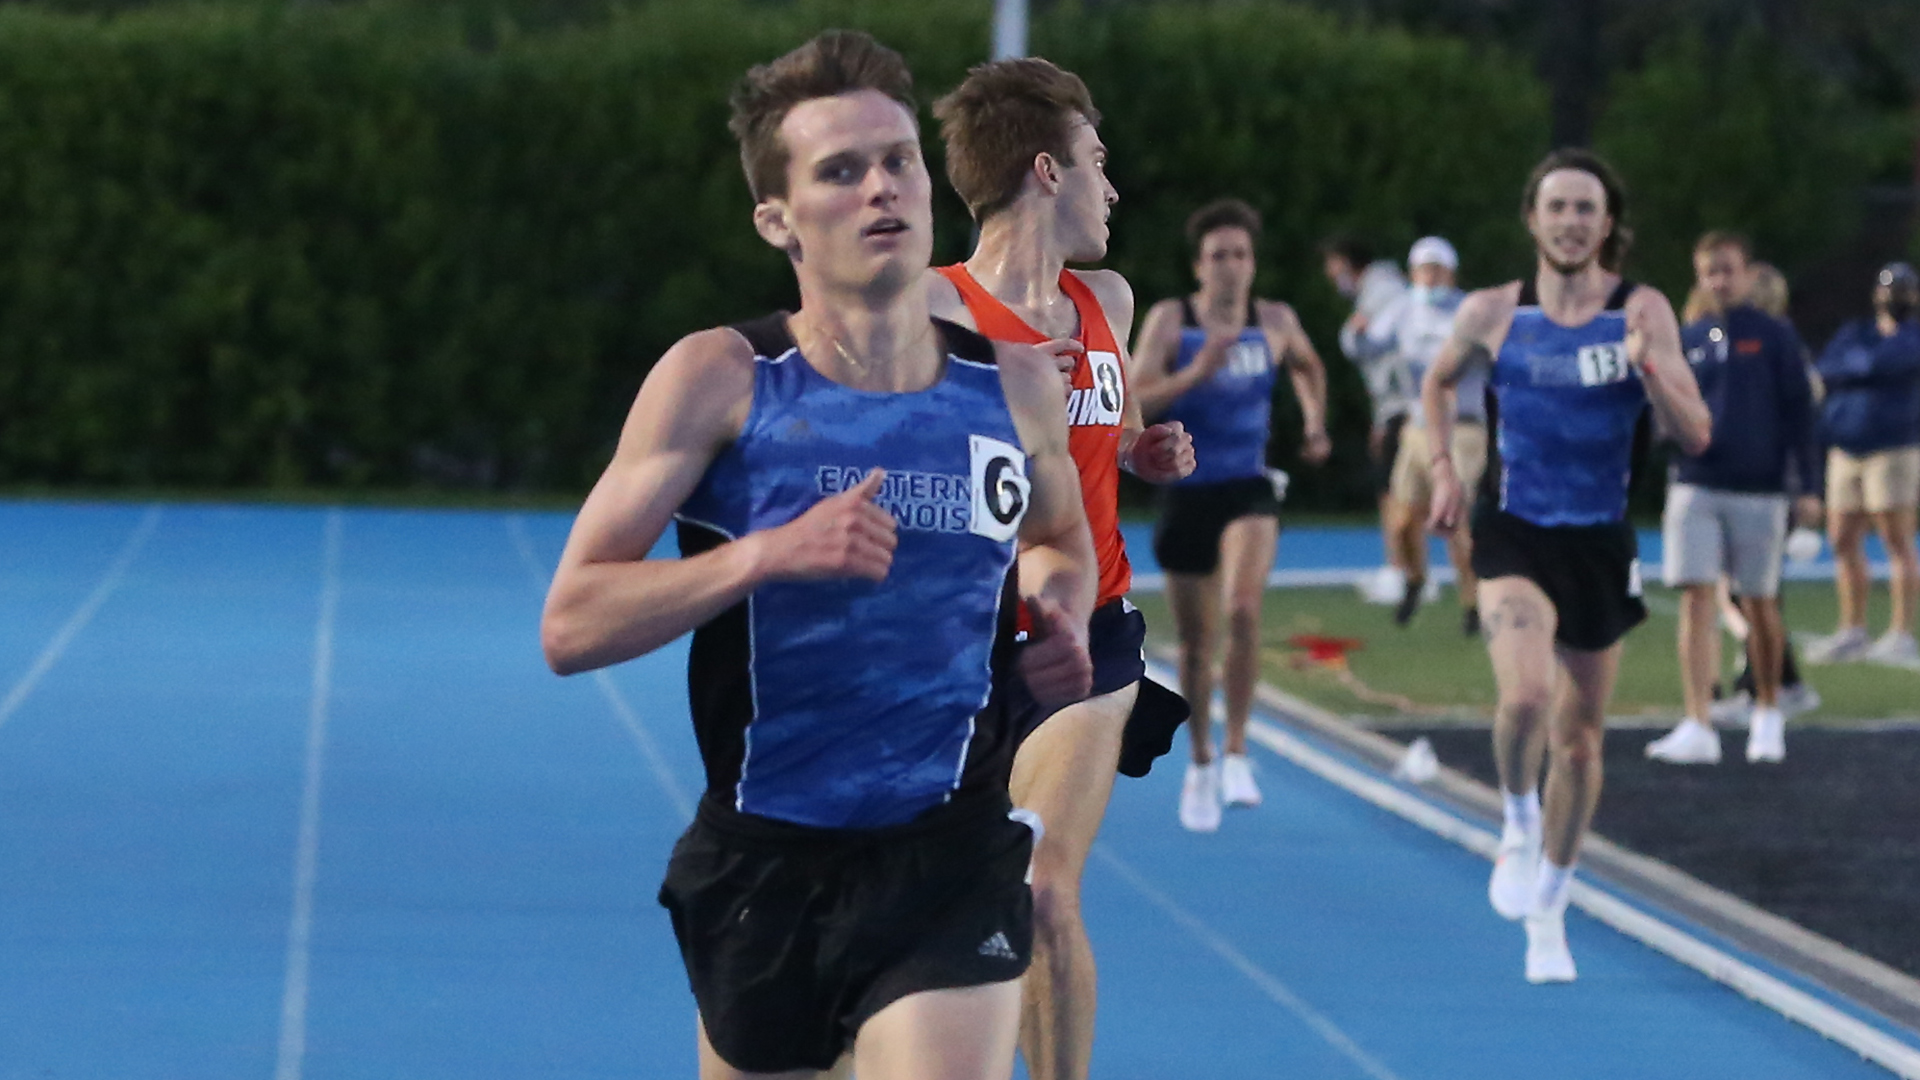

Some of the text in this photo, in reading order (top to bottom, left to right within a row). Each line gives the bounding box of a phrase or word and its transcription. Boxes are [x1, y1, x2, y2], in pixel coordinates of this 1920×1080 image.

[1097, 362, 1120, 412] 8
[817, 466, 971, 503] EATERN
[984, 456, 1023, 525] 6
[879, 501, 968, 533] NOIS
